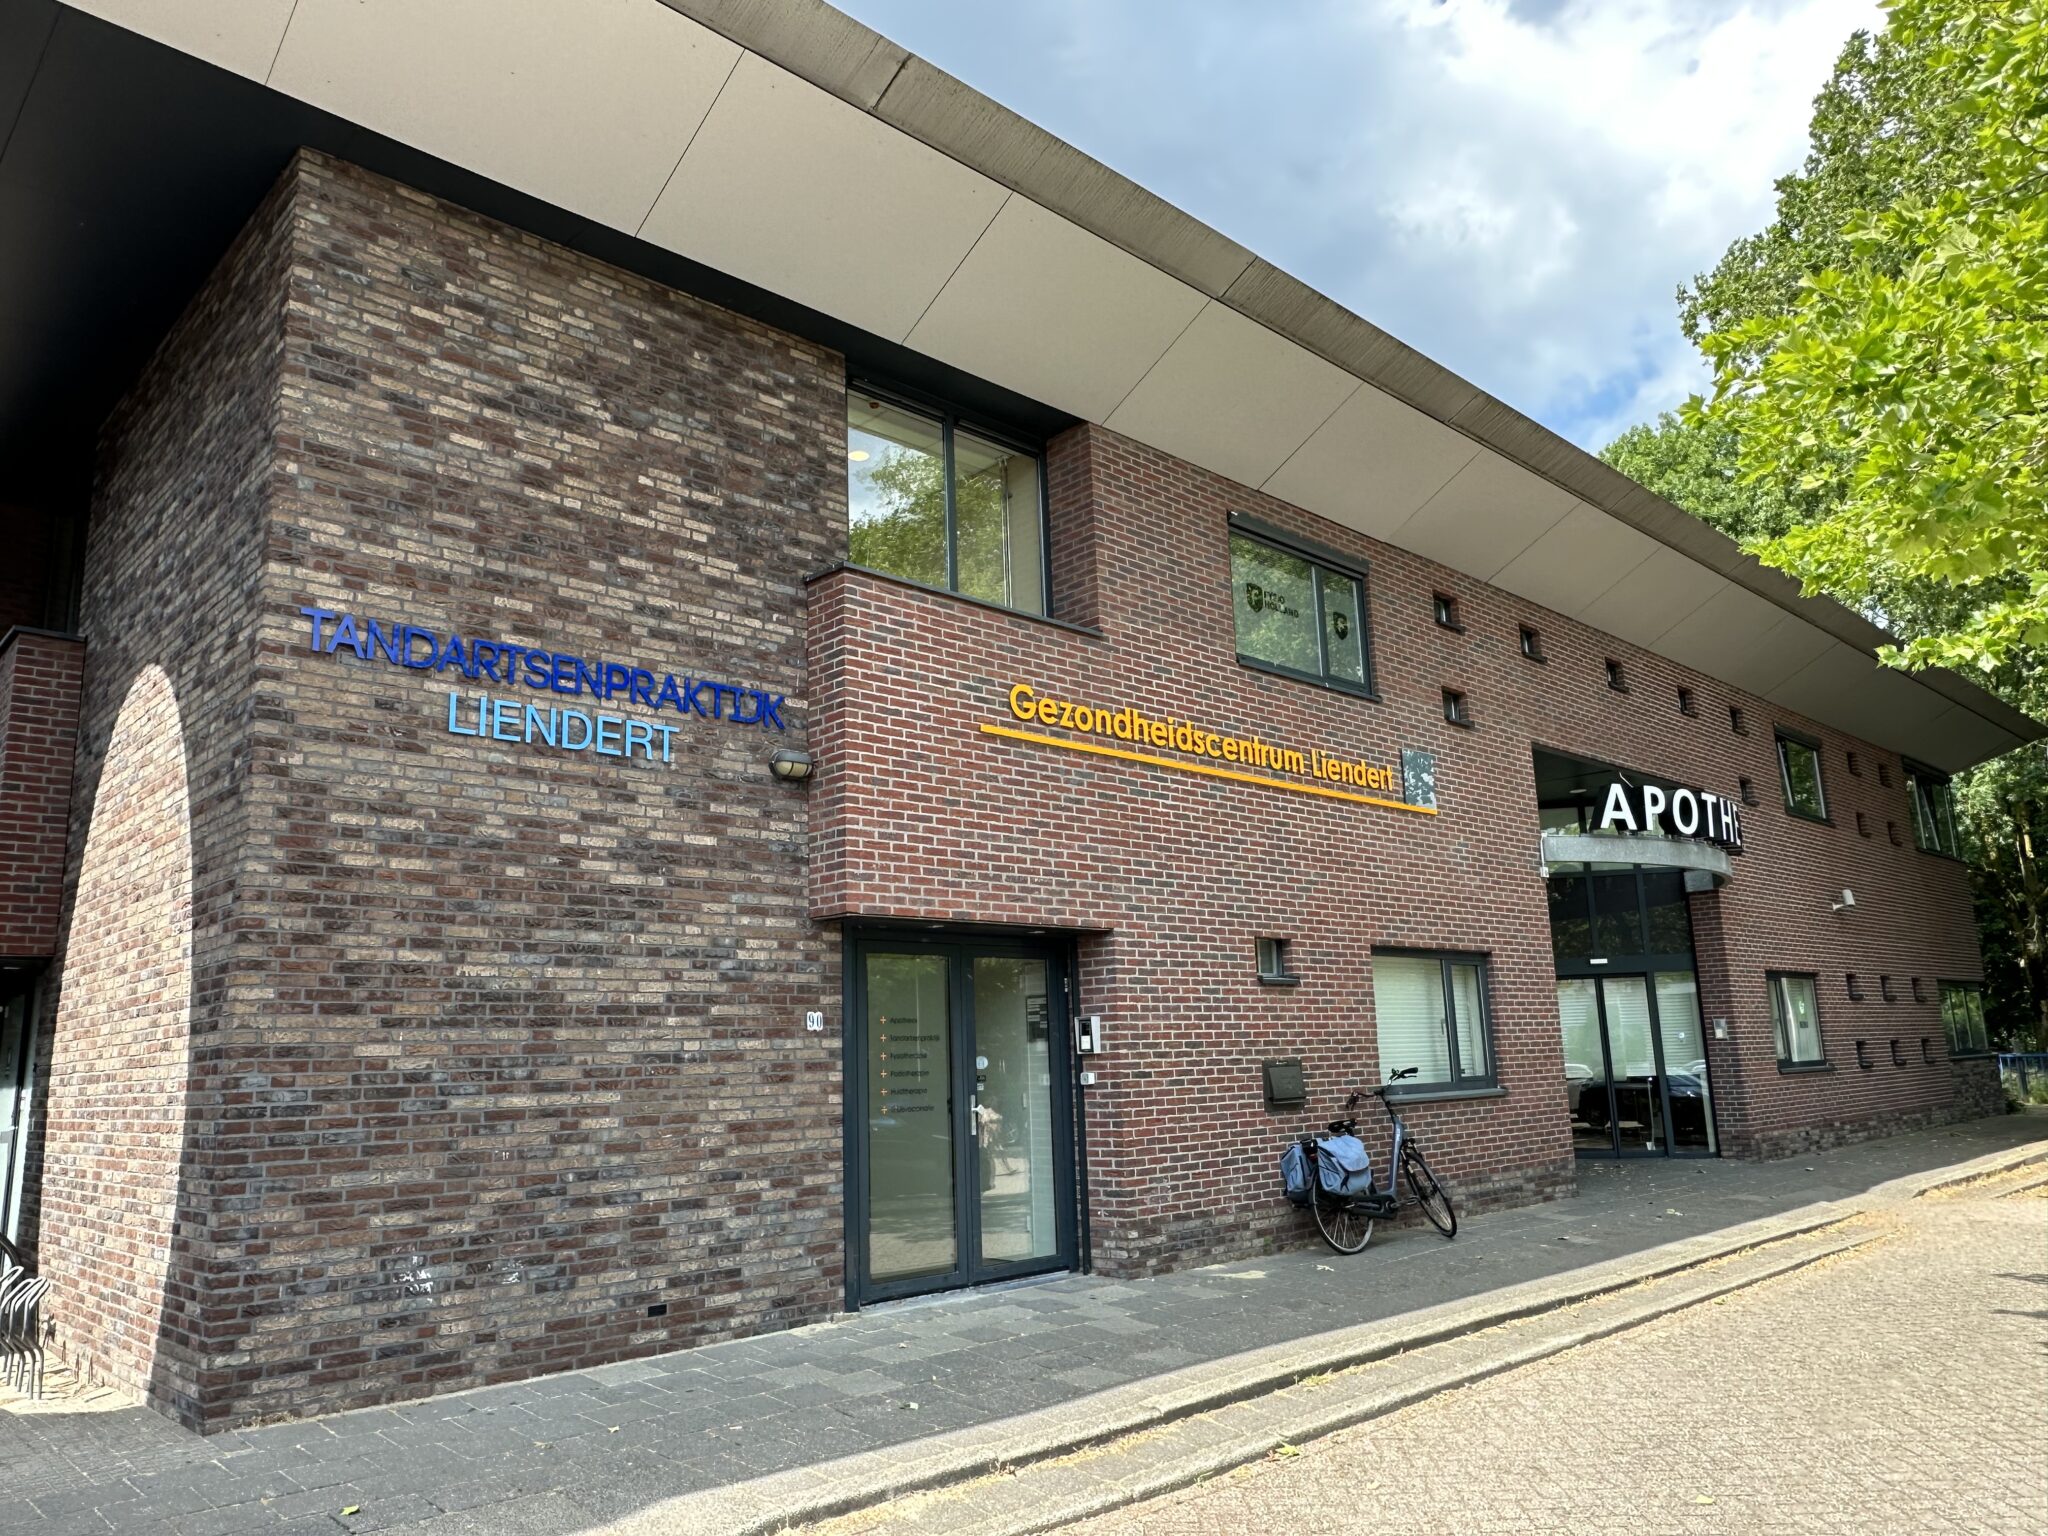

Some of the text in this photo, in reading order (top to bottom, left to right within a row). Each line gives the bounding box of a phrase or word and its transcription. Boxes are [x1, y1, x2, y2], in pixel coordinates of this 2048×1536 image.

[301, 607, 786, 730] TANDARTSENPRAKTIJK
[448, 691, 680, 763] LIENDERT
[1009, 683, 1394, 792] Gezondheidscentrum Liendert
[808, 1012, 822, 1030] 90
